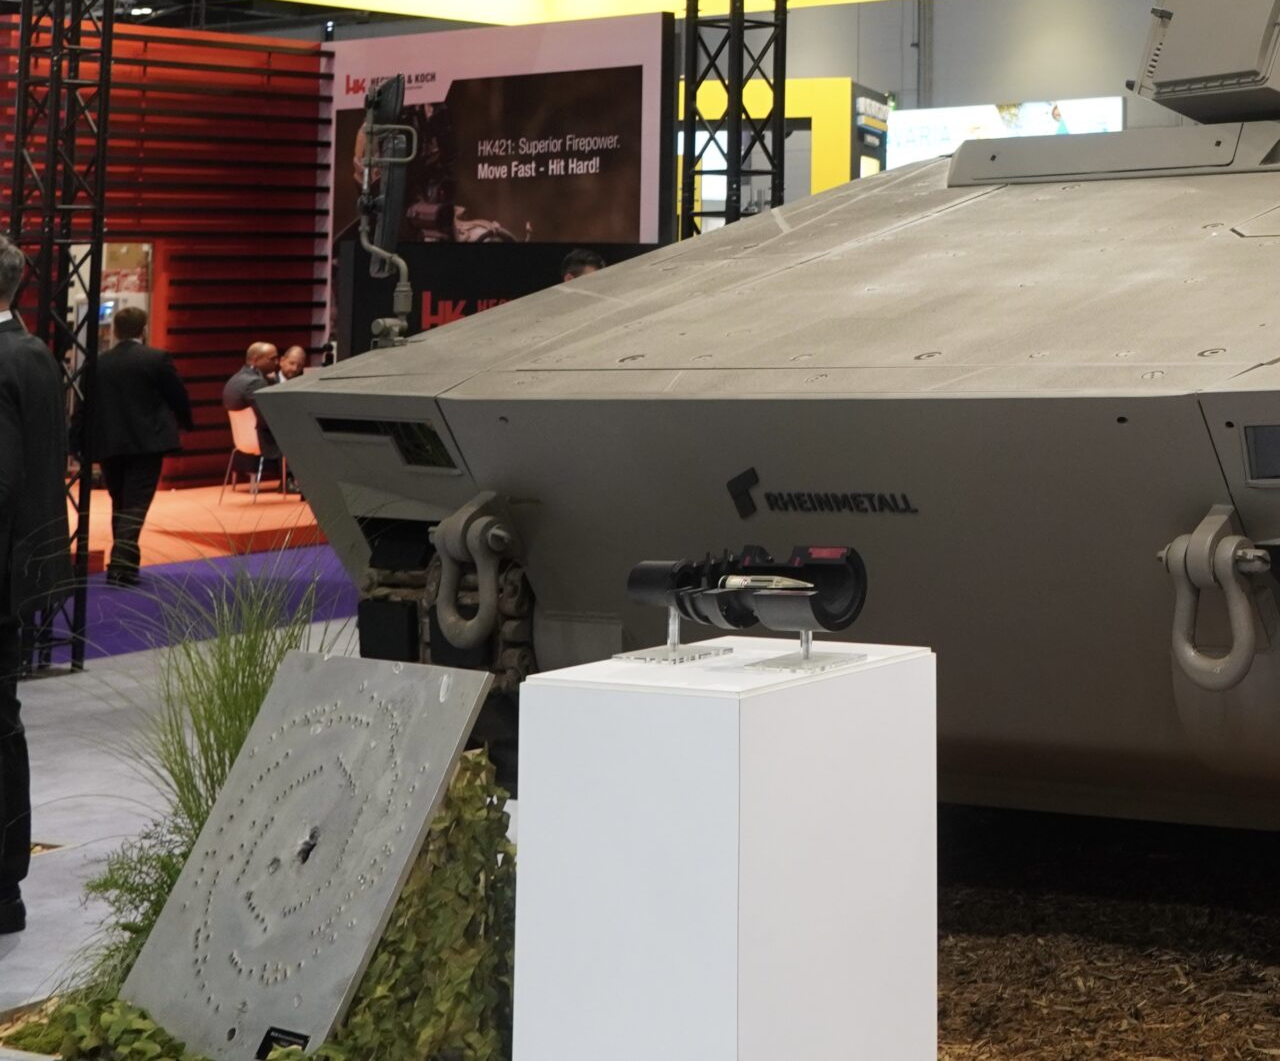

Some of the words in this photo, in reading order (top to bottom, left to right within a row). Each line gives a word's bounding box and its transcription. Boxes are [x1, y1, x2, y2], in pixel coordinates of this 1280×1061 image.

[414, 72, 436, 84] KOCH
[477, 139, 515, 157] HK421:
[518, 137, 562, 157] Superior
[565, 134, 621, 153] Firepower.
[477, 163, 507, 179] Move
[510, 160, 536, 178] Fast
[548, 158, 565, 176] Hit
[568, 156, 600, 174] Hard!
[764, 491, 919, 514] RHEINMETALL
